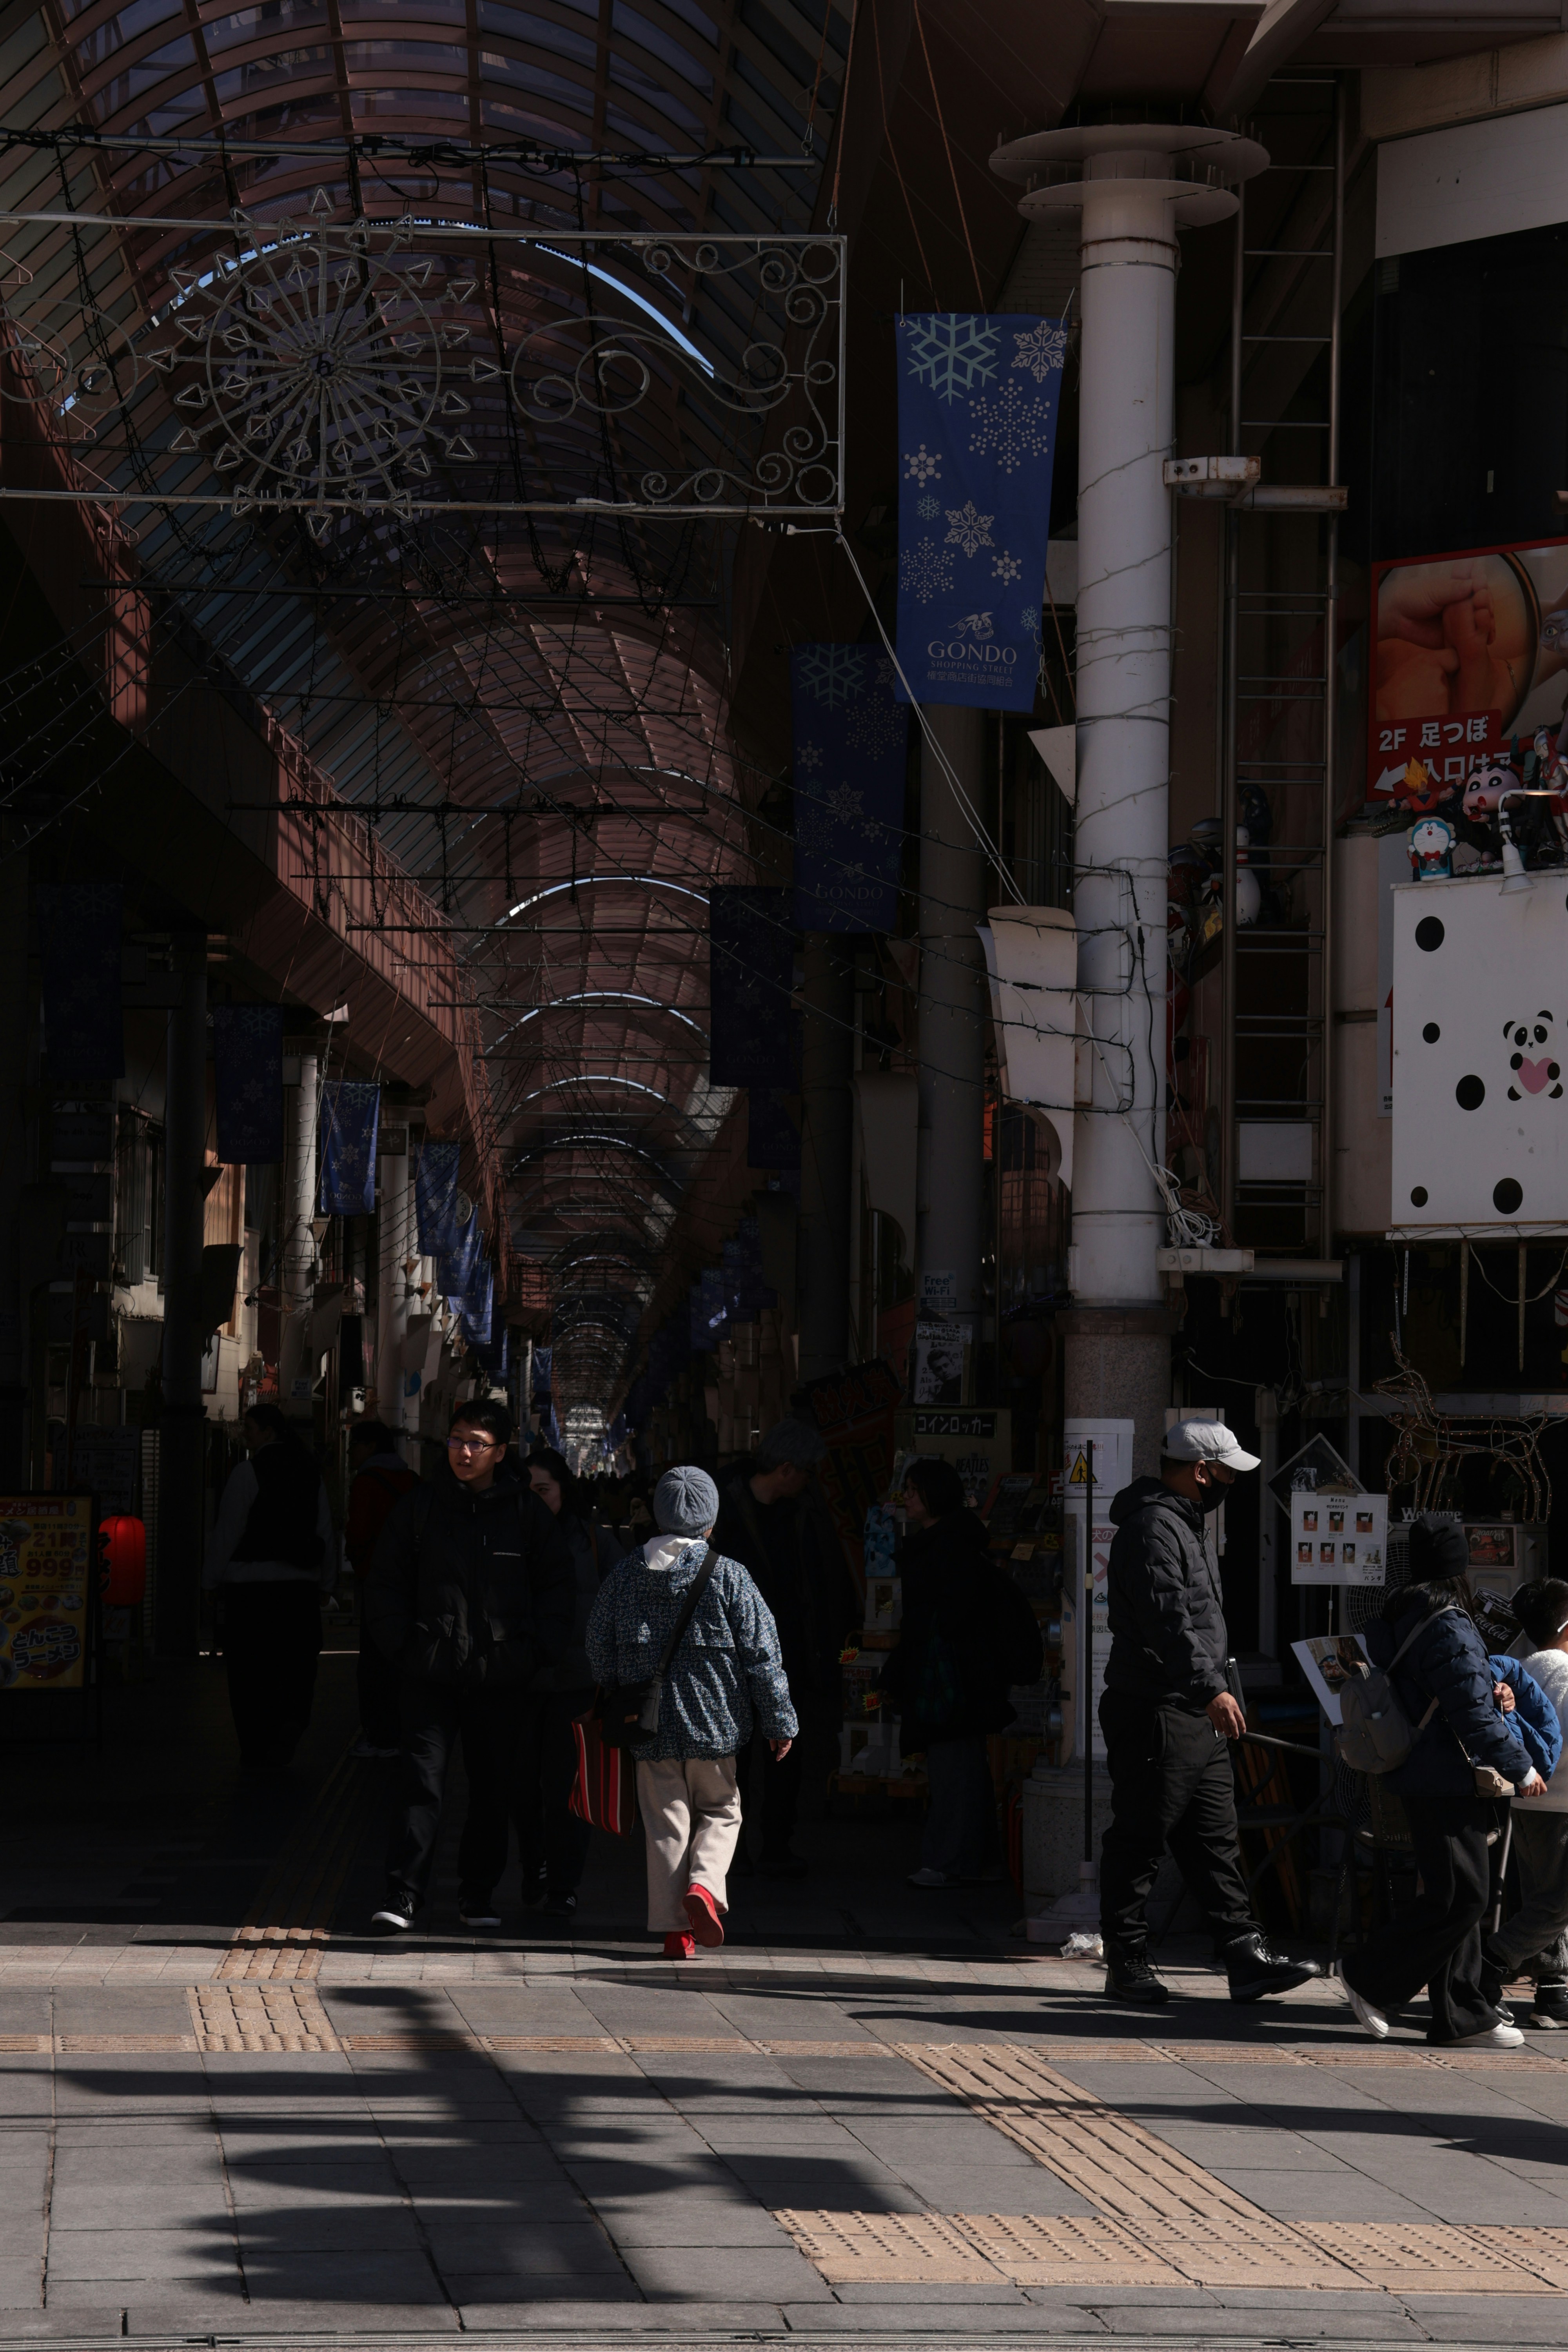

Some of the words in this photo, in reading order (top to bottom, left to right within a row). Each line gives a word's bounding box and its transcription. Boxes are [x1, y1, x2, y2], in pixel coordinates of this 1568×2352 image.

[927, 641, 1017, 664] GONDO
[931, 661, 979, 671] SHOPPING
[983, 664, 1013, 674] STREET
[927, 670, 1013, 687] 権堂商店街協同組合
[1379, 728, 1407, 751] 2F
[1419, 715, 1490, 748] 足つぼ
[815, 886, 883, 900] GONDO
[726, 1054, 775, 1064] GONDO
[924, 1276, 950, 1285] Free
[925, 1286, 950, 1295] Wi-Fi
[918, 1415, 992, 1434] コインロッカー
[956, 1459, 989, 1476] BEATLES
[33, 1532, 77, 1548] 21時
[12, 1624, 78, 1649] とんこつ
[14, 1643, 81, 1669] ラーメン
